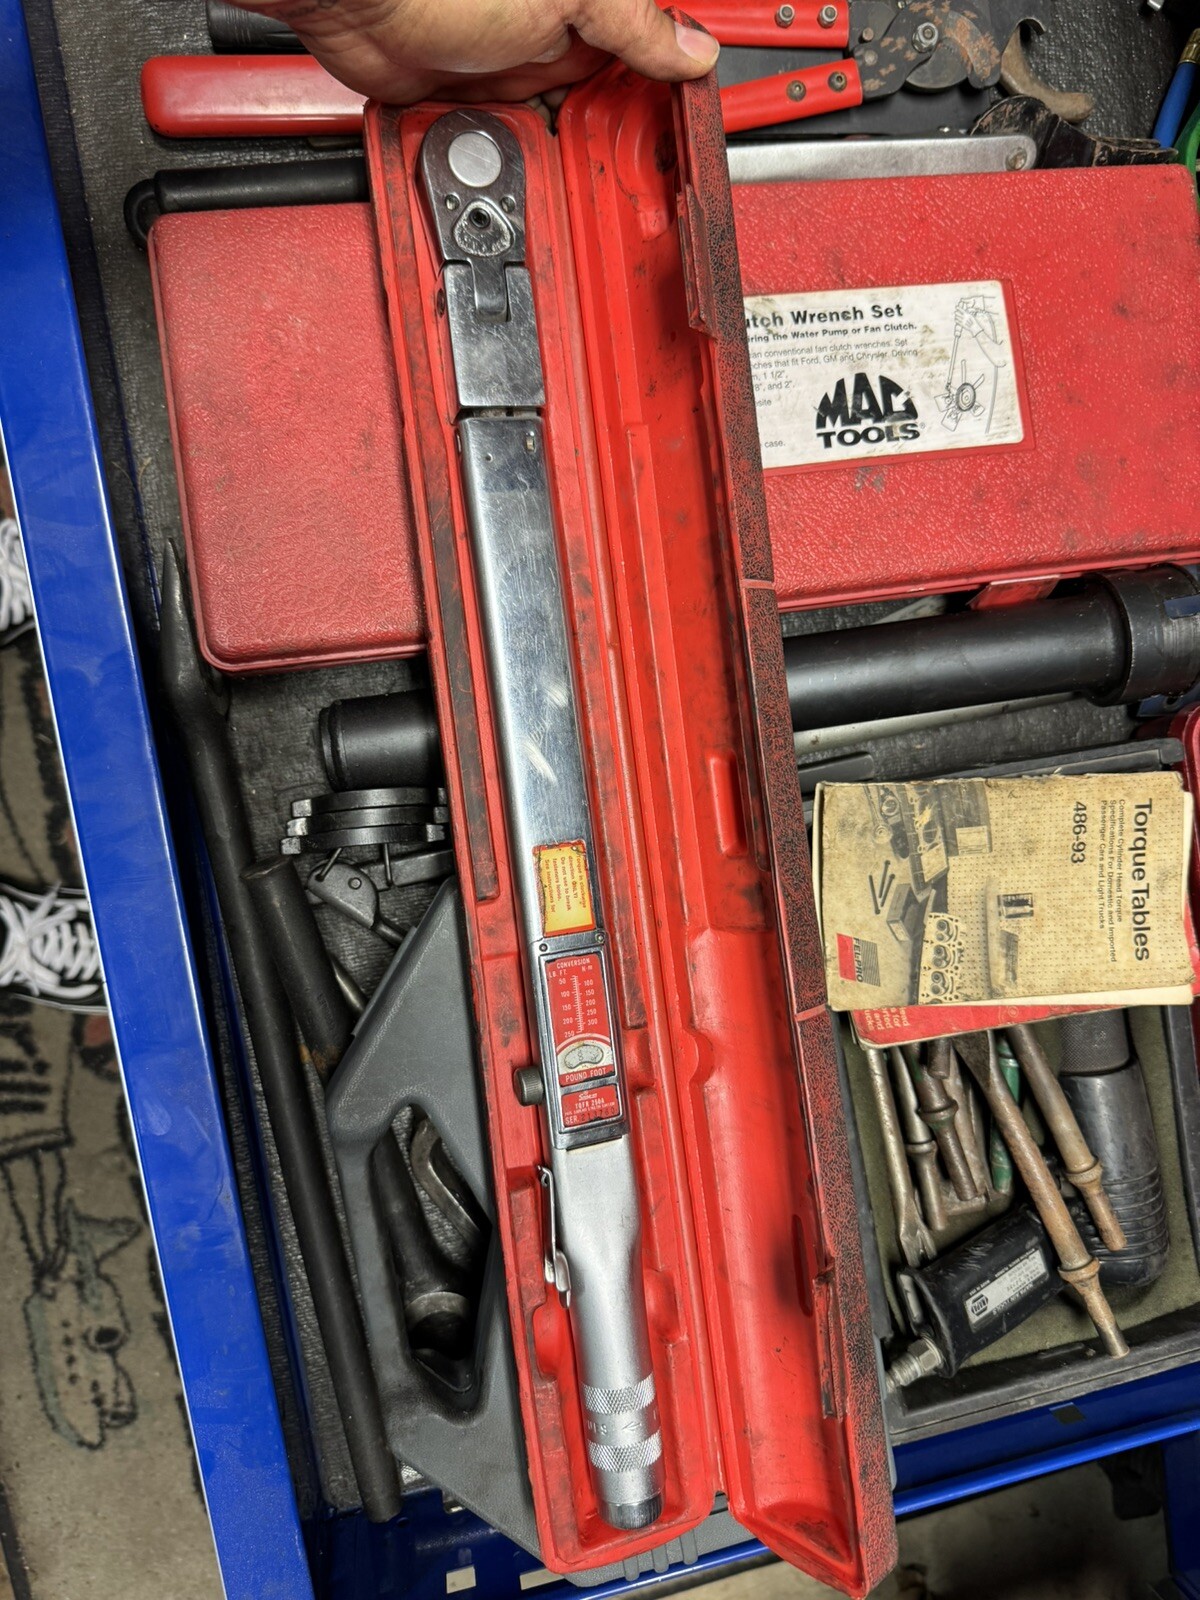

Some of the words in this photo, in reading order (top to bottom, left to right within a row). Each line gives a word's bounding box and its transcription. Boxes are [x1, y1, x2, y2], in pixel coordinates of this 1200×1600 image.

[790, 307, 864, 324] Wrench
[871, 304, 903, 318] Set
[772, 332, 788, 340] the
[791, 330, 818, 338] Water
[822, 328, 848, 337] Pump
[864, 325, 882, 333] Fan
[884, 323, 918, 331] Clutch.
[764, 347, 813, 358] conventional
[830, 342, 852, 351] clutch
[894, 339, 908, 347] Set
[774, 358, 790, 367] that
[791, 357, 800, 365] fit
[801, 356, 821, 365] Ford,
[823, 355, 838, 363] GM
[840, 354, 854, 362] and
[891, 348, 918, 358] Driving
[767, 381, 783, 391] and
[815, 372, 918, 430] MAC
[764, 440, 786, 448] case.
[816, 423, 921, 449] TOOLS
[1109, 799, 1117, 855] Specifications
[1118, 799, 1126, 837] Complete
[1071, 801, 1088, 864] 486-93
[1128, 798, 1152, 881] Torque
[560, 857, 565, 865] Do
[1117, 838, 1125, 869] Cylinder
[546, 871, 554, 903] instructions
[1131, 883, 1151, 961] Tables
[1108, 927, 1118, 962] Imported
[556, 958, 590, 969] CONVERSION
[854, 937, 863, 983] FEL-PRO
[874, 1013, 884, 1031] and
[566, 1072, 587, 1082] POUND
[590, 1068, 606, 1078] FOOT
[971, 1295, 988, 1314] NAPA
